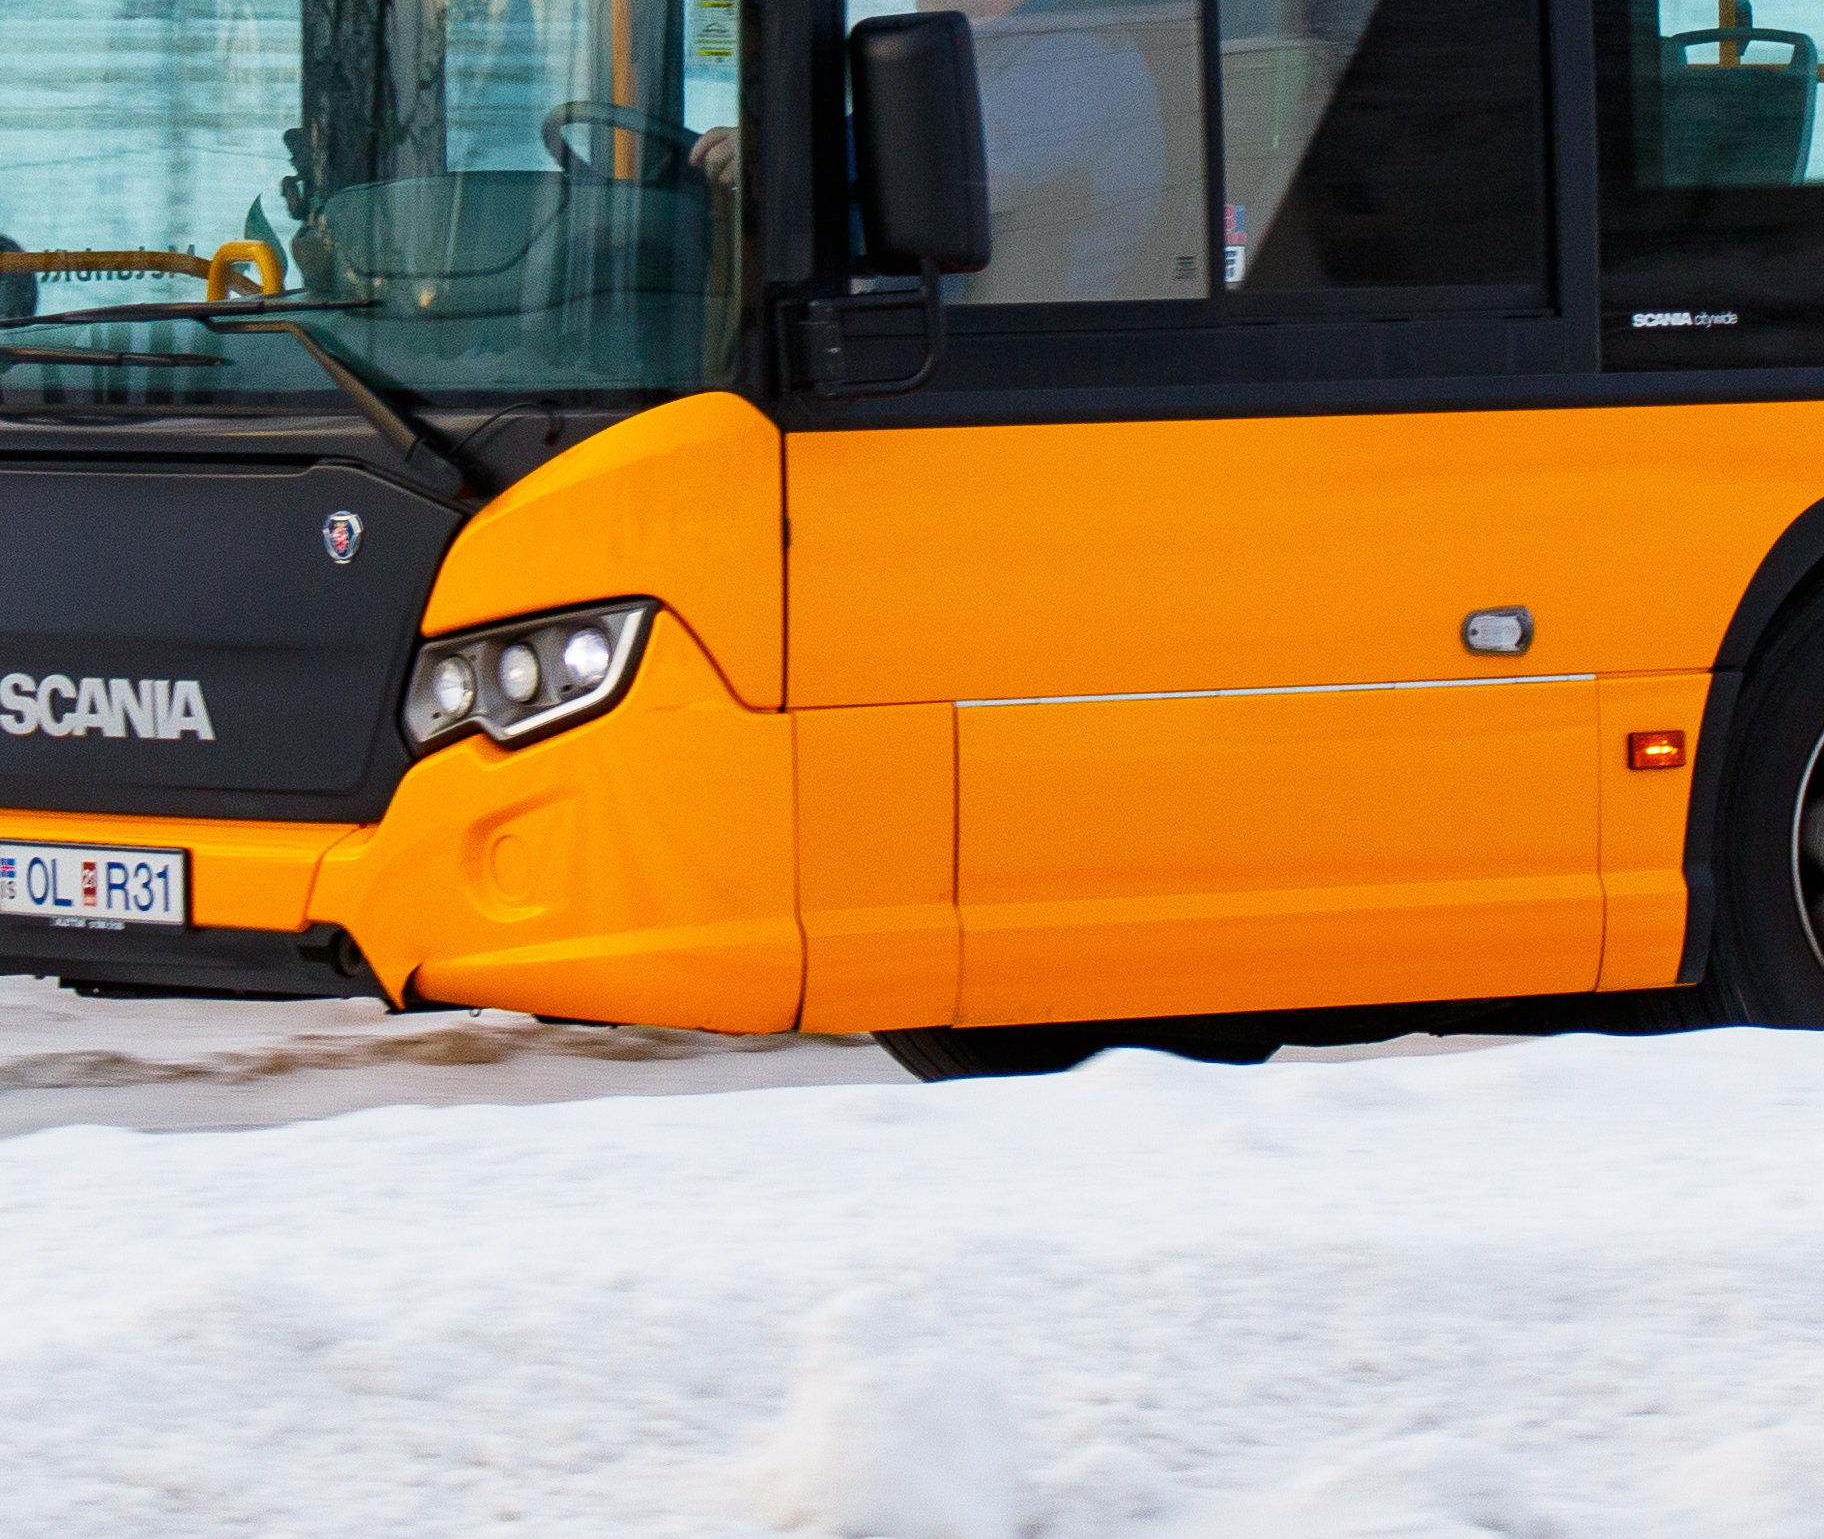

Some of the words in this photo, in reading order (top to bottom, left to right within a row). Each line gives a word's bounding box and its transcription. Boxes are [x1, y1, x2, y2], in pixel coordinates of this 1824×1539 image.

[1632, 312, 1692, 327] SCANIA
[26, 856, 74, 907] OL
[106, 861, 170, 913] R31
